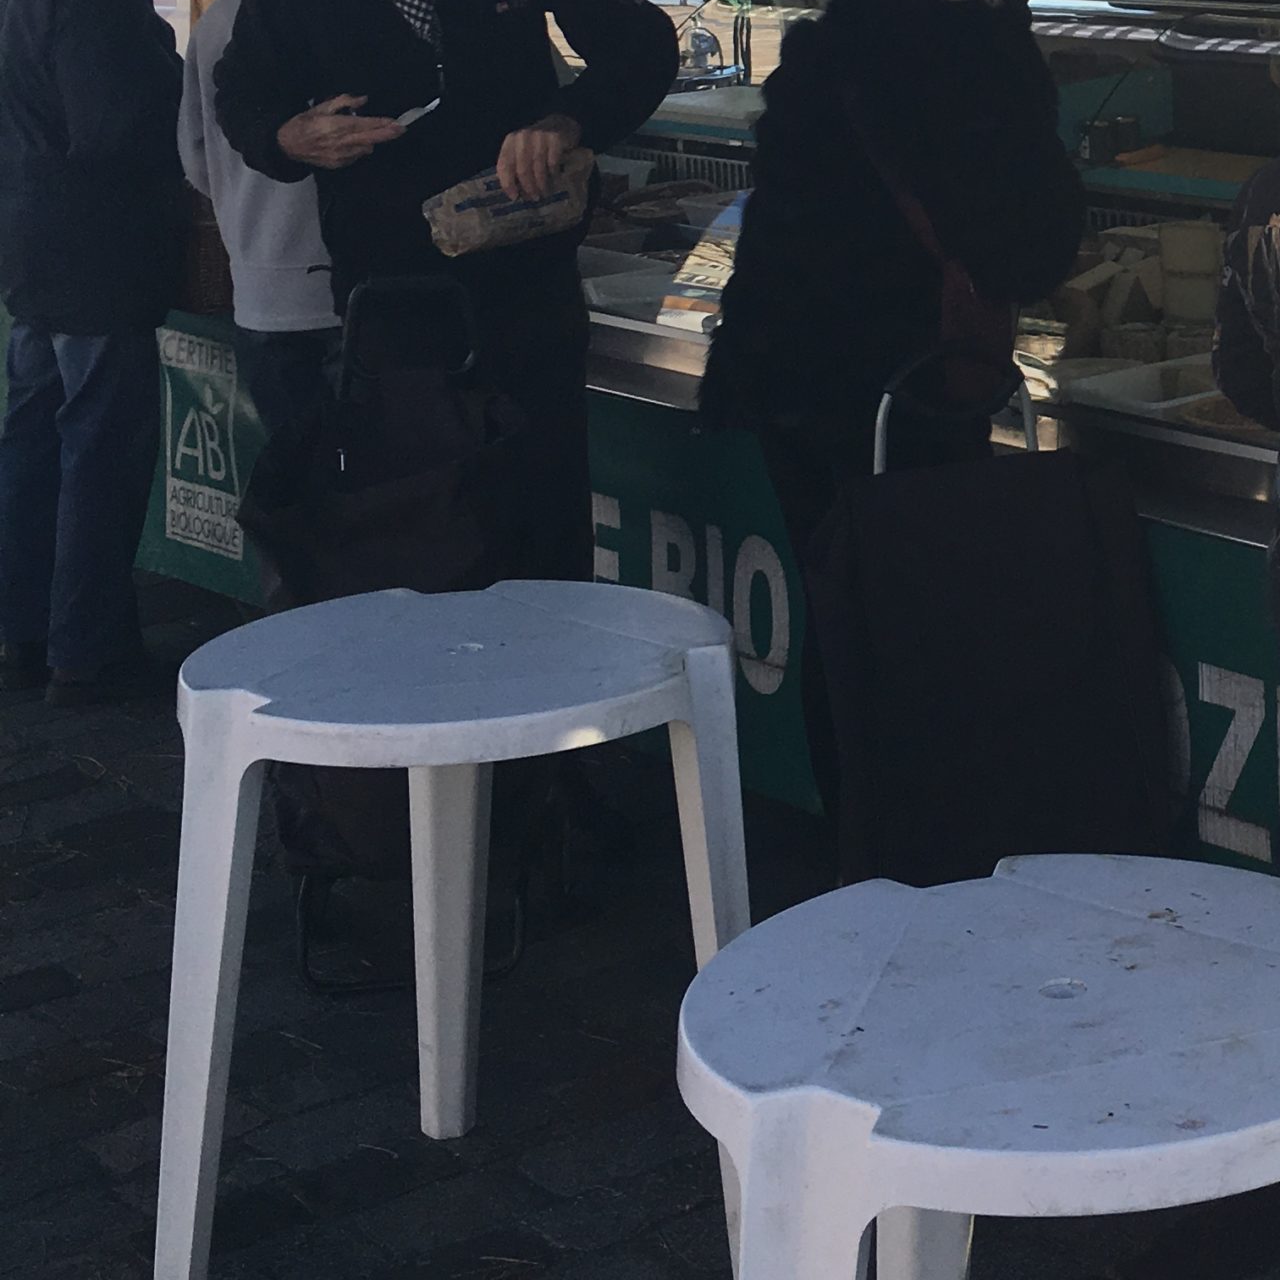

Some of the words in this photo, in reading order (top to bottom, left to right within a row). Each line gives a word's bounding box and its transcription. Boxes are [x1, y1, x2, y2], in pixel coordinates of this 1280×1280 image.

[174, 407, 226, 481] AB
[170, 508, 240, 548] BIOLOGIQUE
[651, 509, 790, 695] BIO
